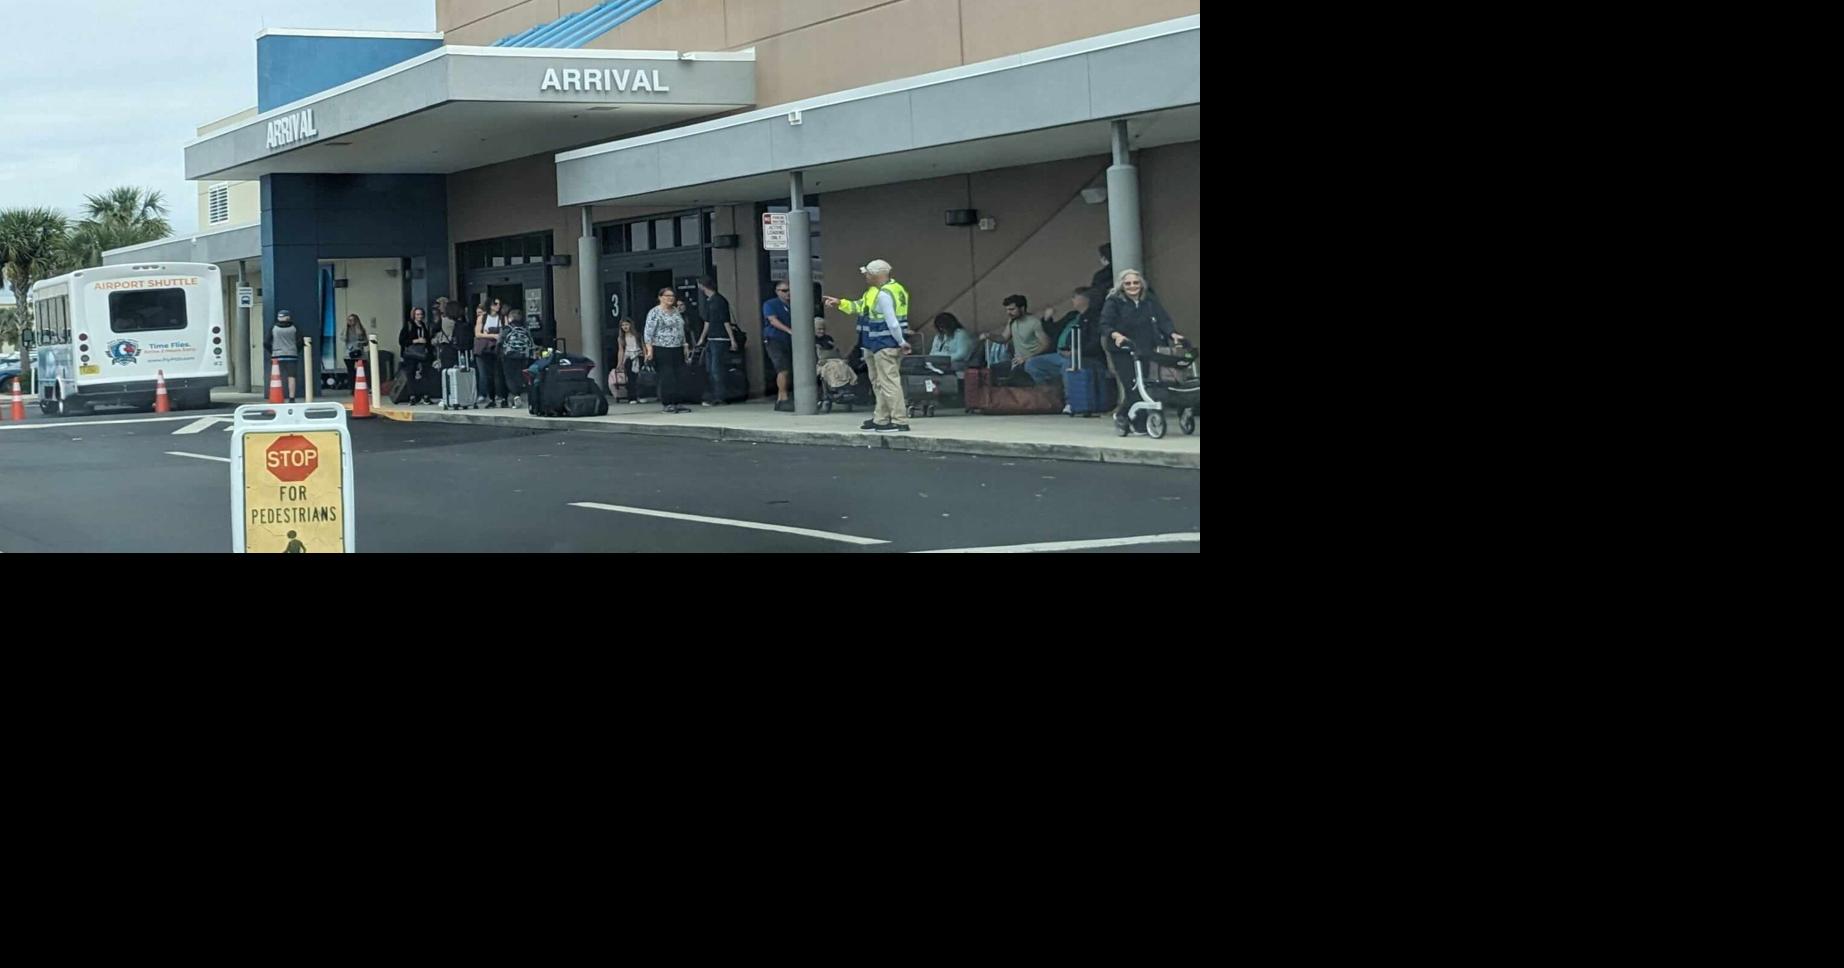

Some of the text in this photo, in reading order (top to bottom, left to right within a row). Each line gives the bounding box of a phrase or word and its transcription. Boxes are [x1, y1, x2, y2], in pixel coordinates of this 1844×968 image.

[541, 68, 670, 92] ARRIVAL
[266, 108, 319, 149] ARRIVAL
[94, 277, 198, 290] AIRPORT SHUTTLE
[611, 293, 620, 317] 3
[267, 449, 318, 468] STOP
[279, 485, 307, 502] FOR
[251, 506, 337, 525] PEDESTRIANS
